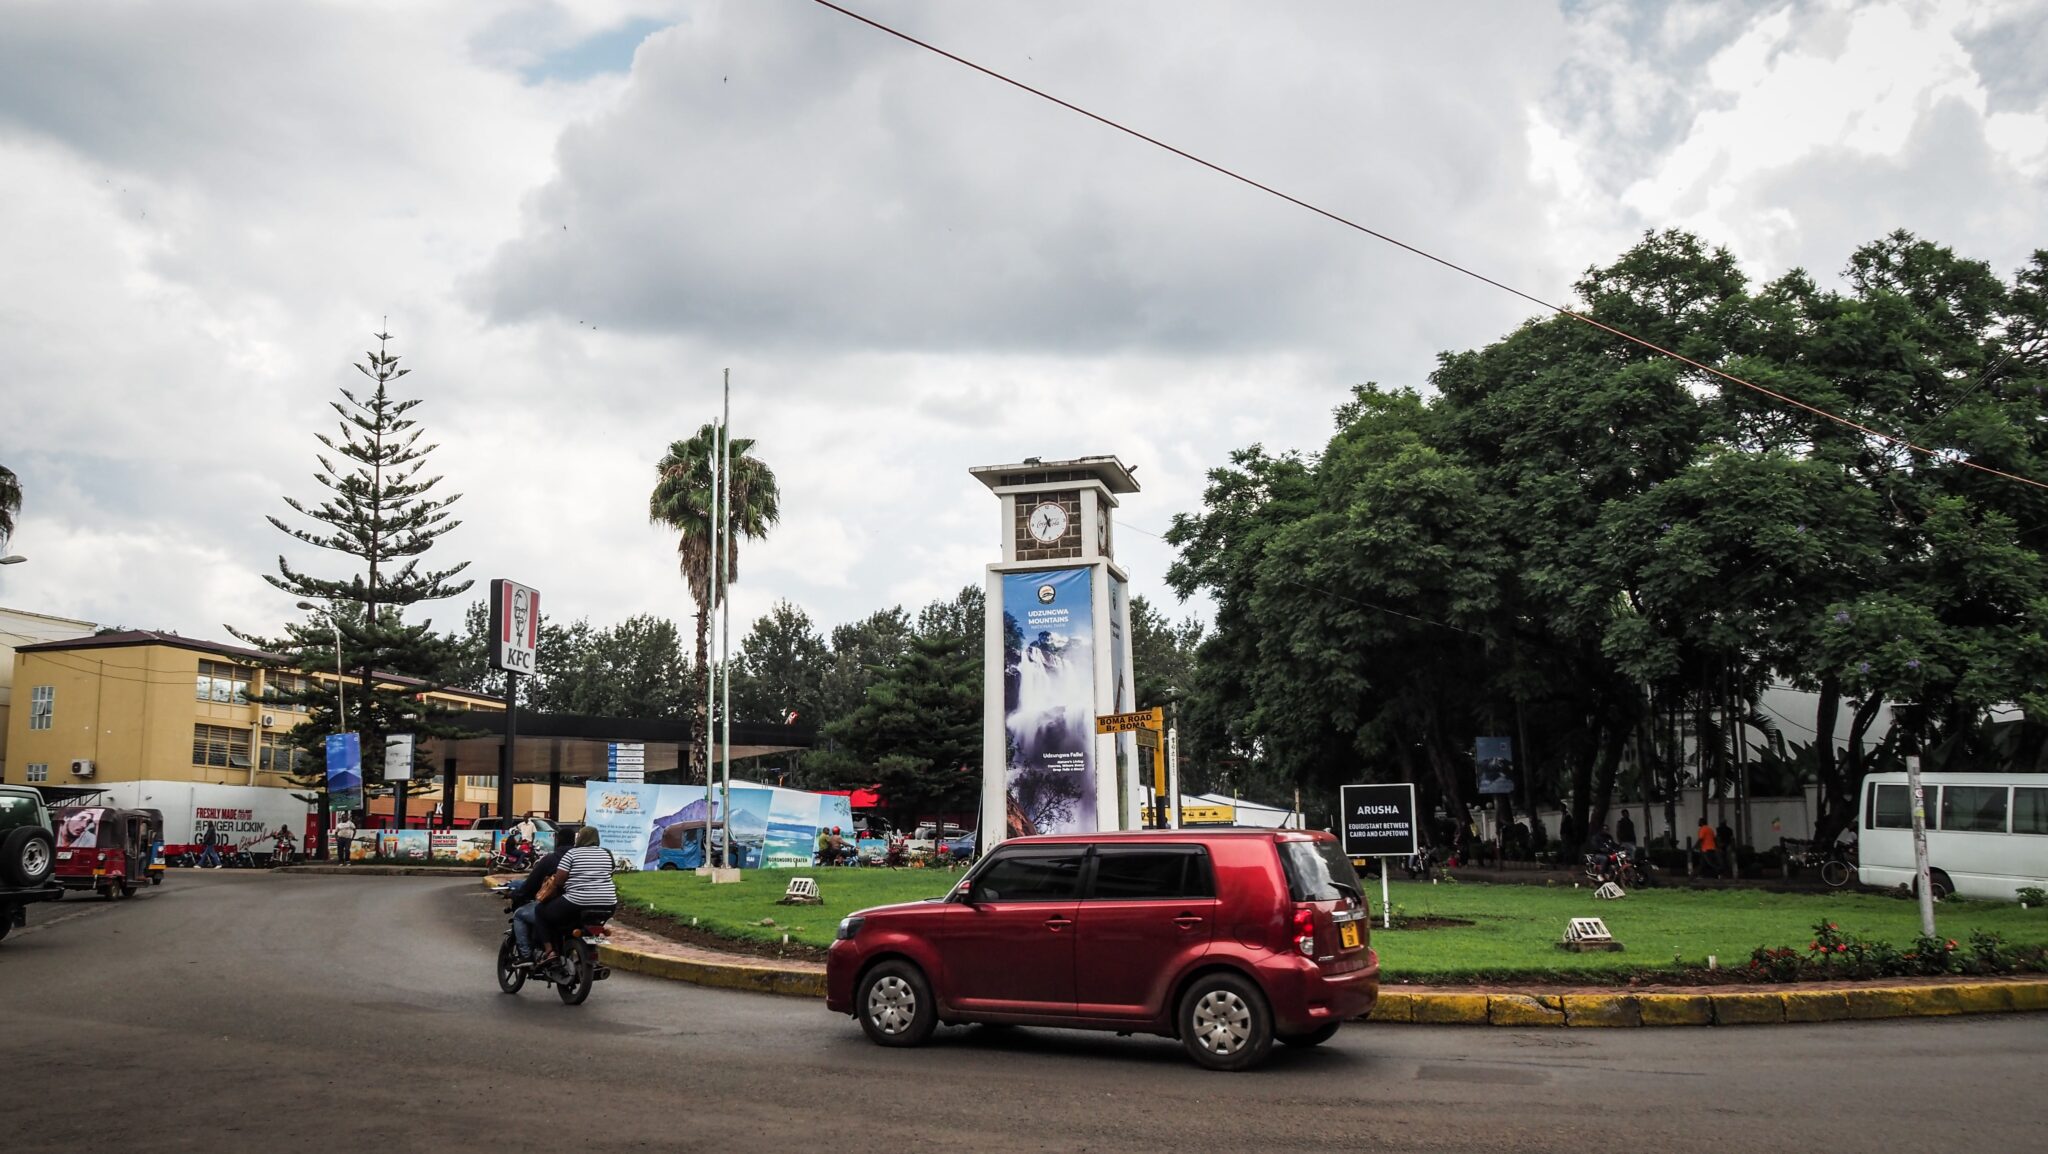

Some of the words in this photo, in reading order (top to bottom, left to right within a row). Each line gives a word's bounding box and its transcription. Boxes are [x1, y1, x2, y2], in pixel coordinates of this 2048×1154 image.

[1028, 608, 1069, 617] UDZUNGWA
[1028, 616, 1069, 625] MOUNTAINS
[506, 647, 531, 669] KFC
[1100, 716, 1125, 726] BOMA
[1127, 714, 1153, 723] ROAD
[1119, 721, 1146, 730] BOMA
[196, 807, 221, 819] FRESHLY
[221, 808, 237, 820] MADE
[1356, 805, 1400, 815] ARUSHA
[202, 820, 234, 832] FGER
[194, 832, 229, 846] GD
